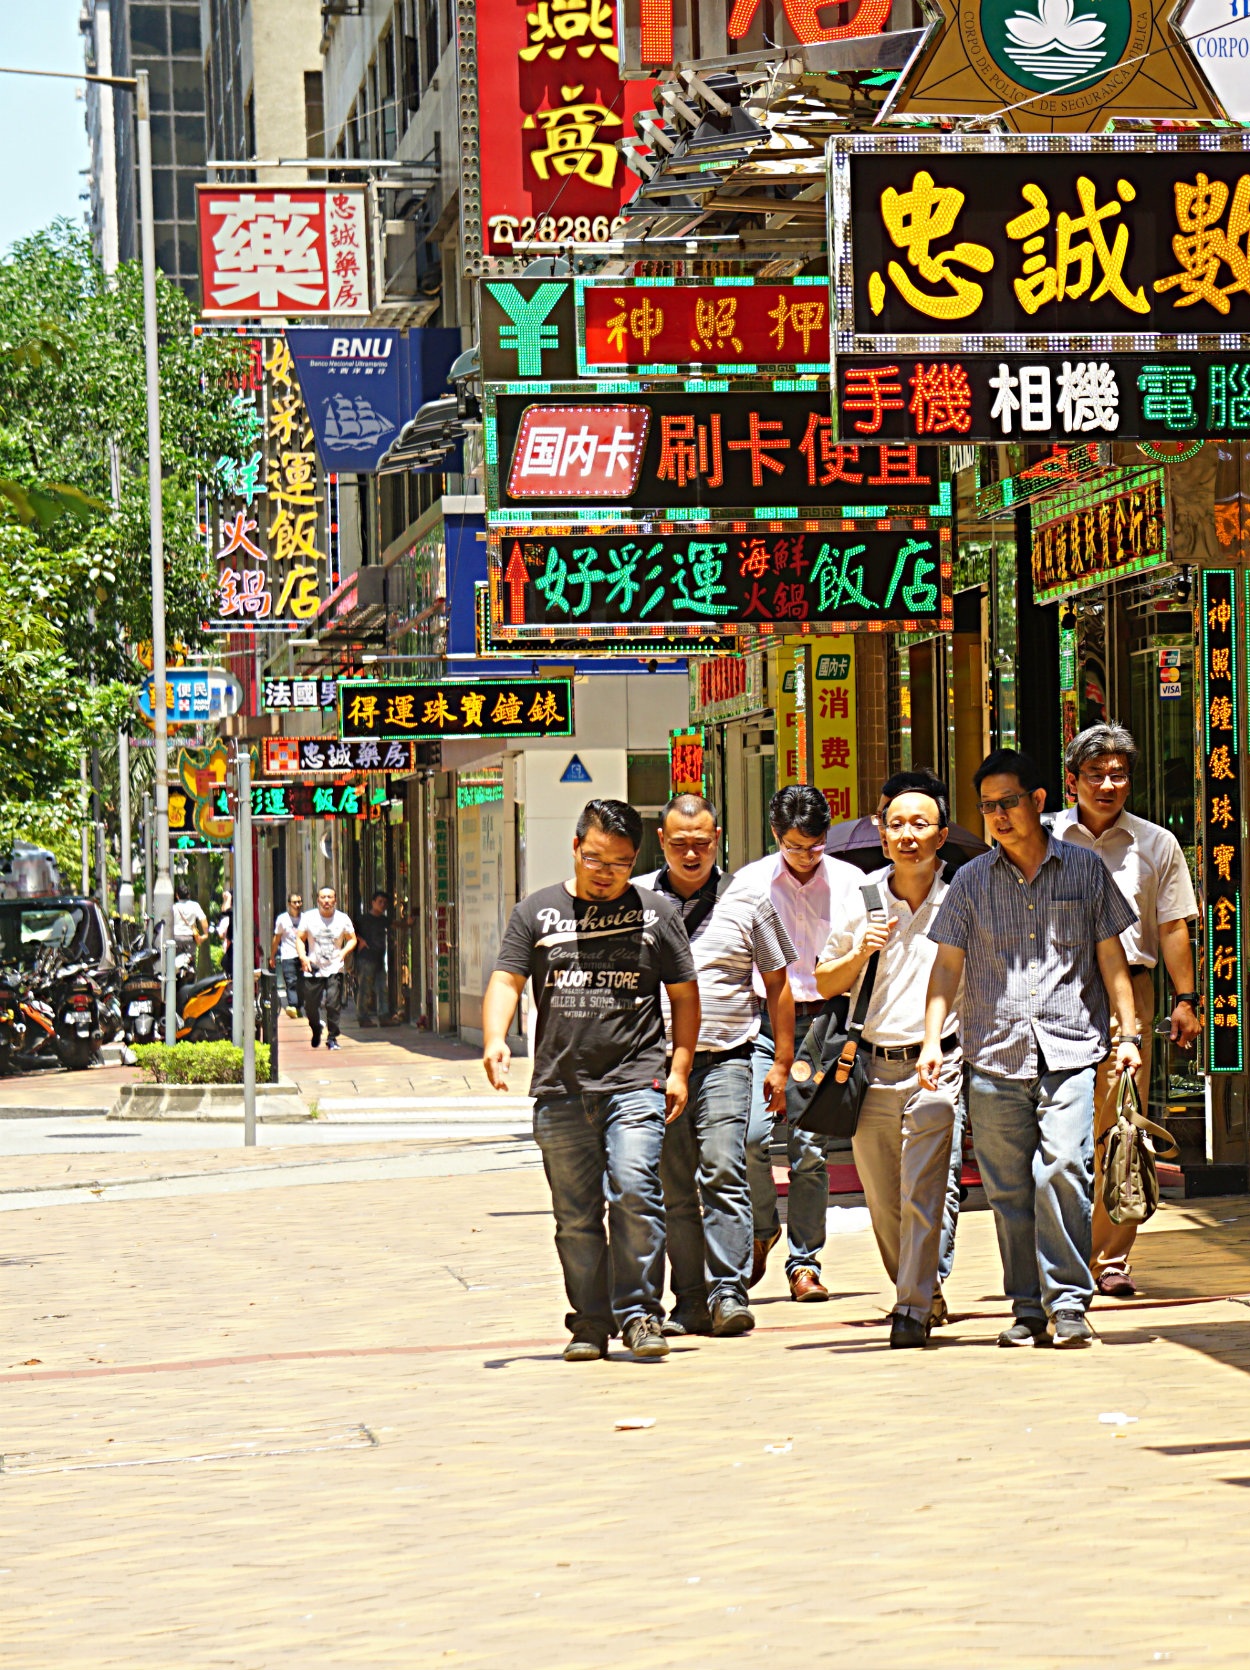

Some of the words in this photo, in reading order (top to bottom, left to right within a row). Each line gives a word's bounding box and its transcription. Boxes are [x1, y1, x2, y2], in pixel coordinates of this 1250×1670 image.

[963, 11, 982, 55] CORPO
[976, 56, 990, 75] DE
[1040, 100, 1057, 112] DE
[1061, 68, 1130, 113] SEGURANÇA
[1196, 37, 1249, 59] CORPO
[209, 194, 327, 308] 藥
[328, 191, 363, 309] 忠誠藥房
[606, 294, 826, 357] 神照押
[330, 338, 393, 358] BNU
[843, 362, 973, 435] 手機
[989, 361, 1121, 435] 相機
[520, 425, 636, 478] 国内卡
[535, 541, 739, 618] 好彩運
[810, 537, 937, 614] 飯店
[177, 682, 208, 698] 便民
[1162, 685, 1180, 694] VISA
[347, 691, 565, 729] 得運珠寶鐘錶
[301, 741, 408, 769] 忠誠藥房
[1208, 598, 1236, 982] 神照鐘錶珠寶金行
[536, 905, 660, 934] Parkview
[545, 969, 593, 989] LIQUOR
[595, 970, 641, 990] STORE
[579, 996, 586, 1008] &
[589, 995, 615, 1009] SONS
